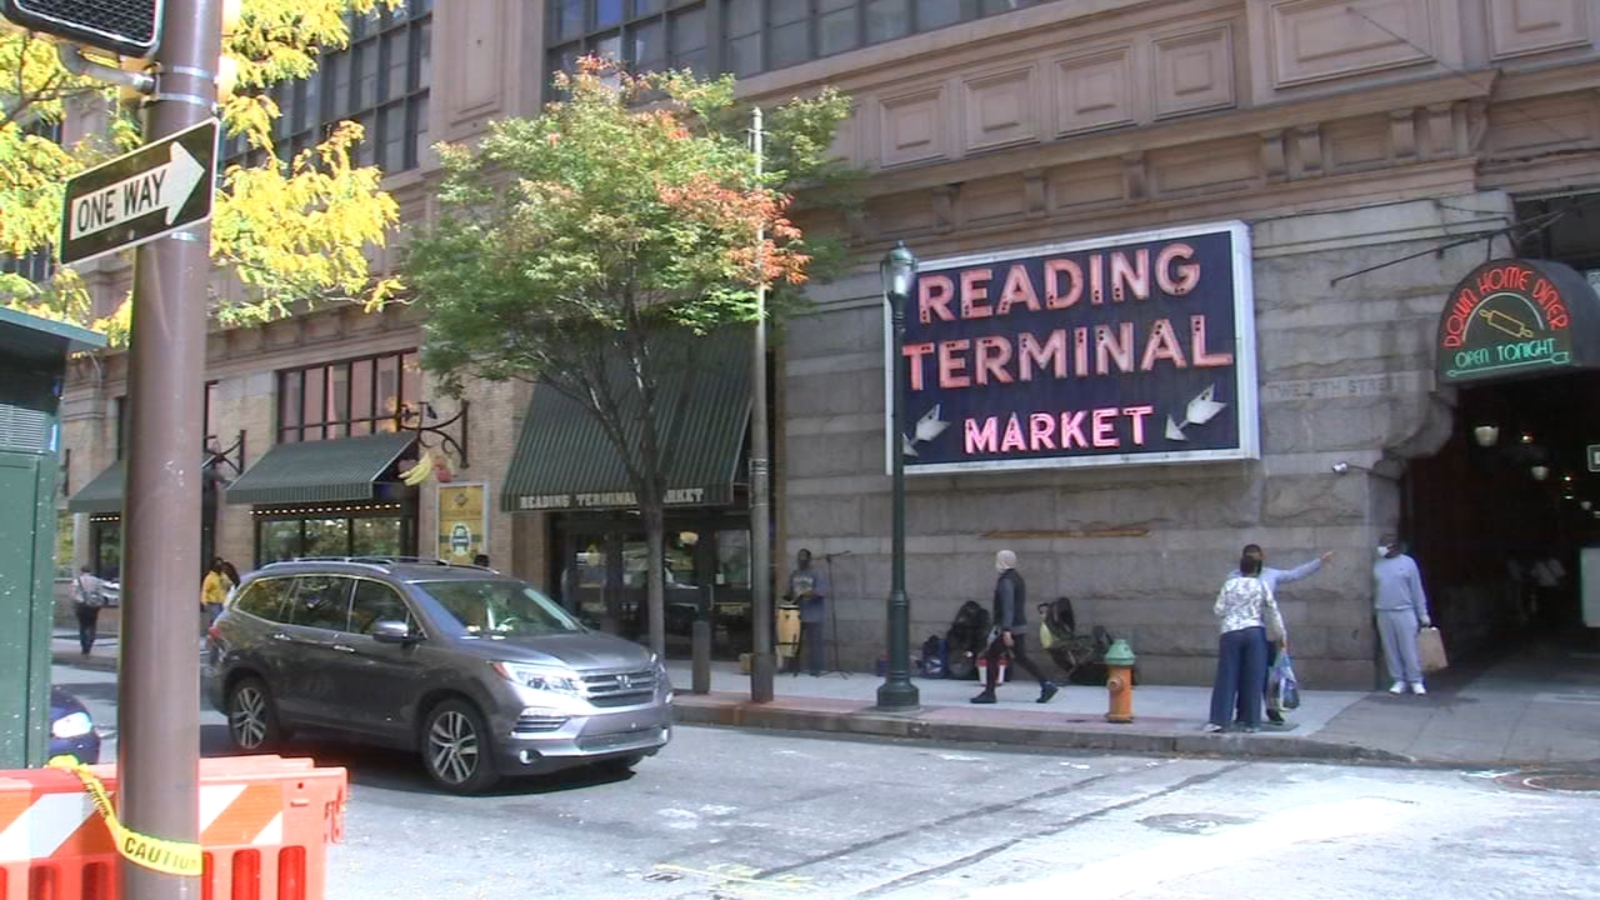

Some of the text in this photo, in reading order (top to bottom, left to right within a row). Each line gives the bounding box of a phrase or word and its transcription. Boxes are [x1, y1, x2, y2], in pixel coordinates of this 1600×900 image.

[77, 169, 167, 232] ONE WAY
[918, 242, 1200, 324] READING
[1442, 265, 1570, 347] DOWN HOME DINER
[902, 314, 1234, 391] TERMINAL
[1454, 338, 1556, 368] OPEN TONIGHT
[963, 404, 1153, 455] MARKET
[661, 488, 704, 504] ARKET
